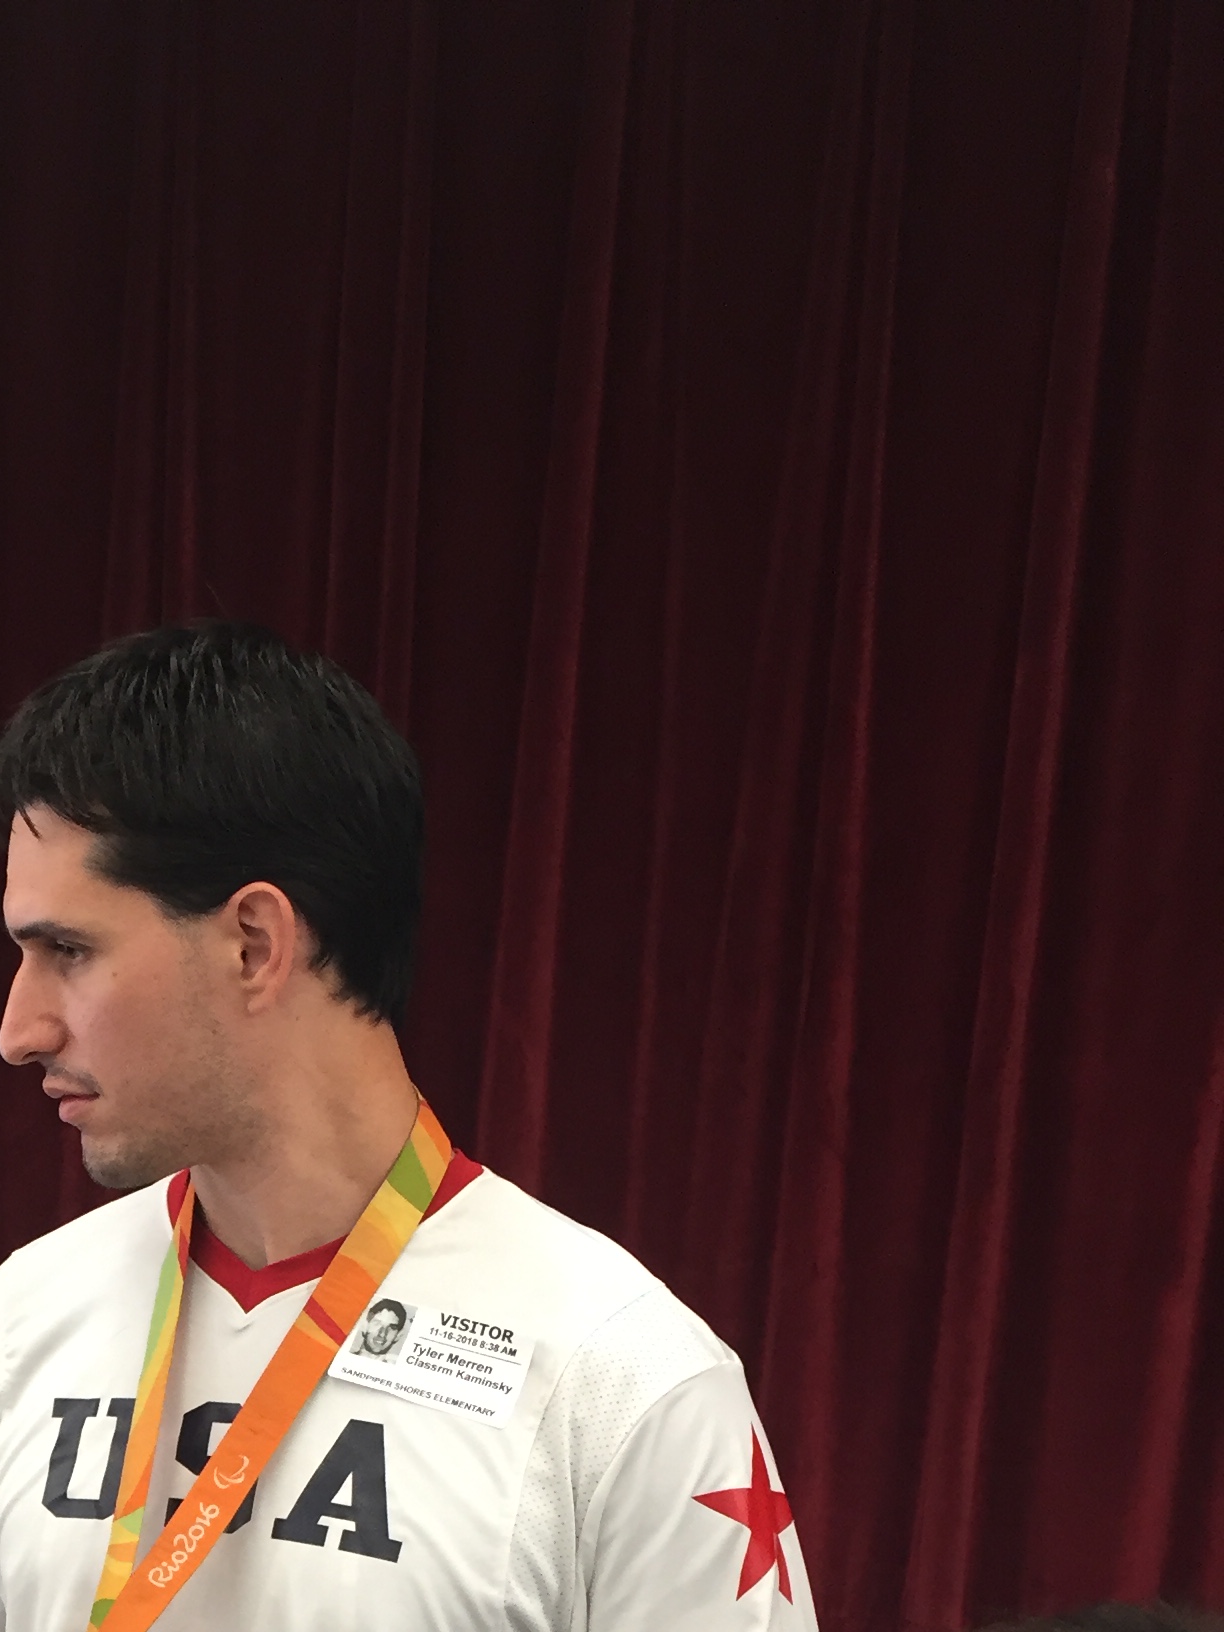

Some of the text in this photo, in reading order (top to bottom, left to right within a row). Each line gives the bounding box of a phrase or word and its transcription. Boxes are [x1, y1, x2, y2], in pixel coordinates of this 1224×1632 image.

[429, 1326, 517, 1357] 11-16-2018 8:38 AM
[440, 1312, 515, 1344] VISITOR
[405, 1355, 513, 1395] Classrm Kaminsky
[412, 1342, 493, 1374] Tyler Merren
[340, 1366, 496, 1417] SANDPIPER SHORES ELEMENTARY
[42, 1396, 403, 1563] USA
[147, 1501, 220, 1588] Rio2016
